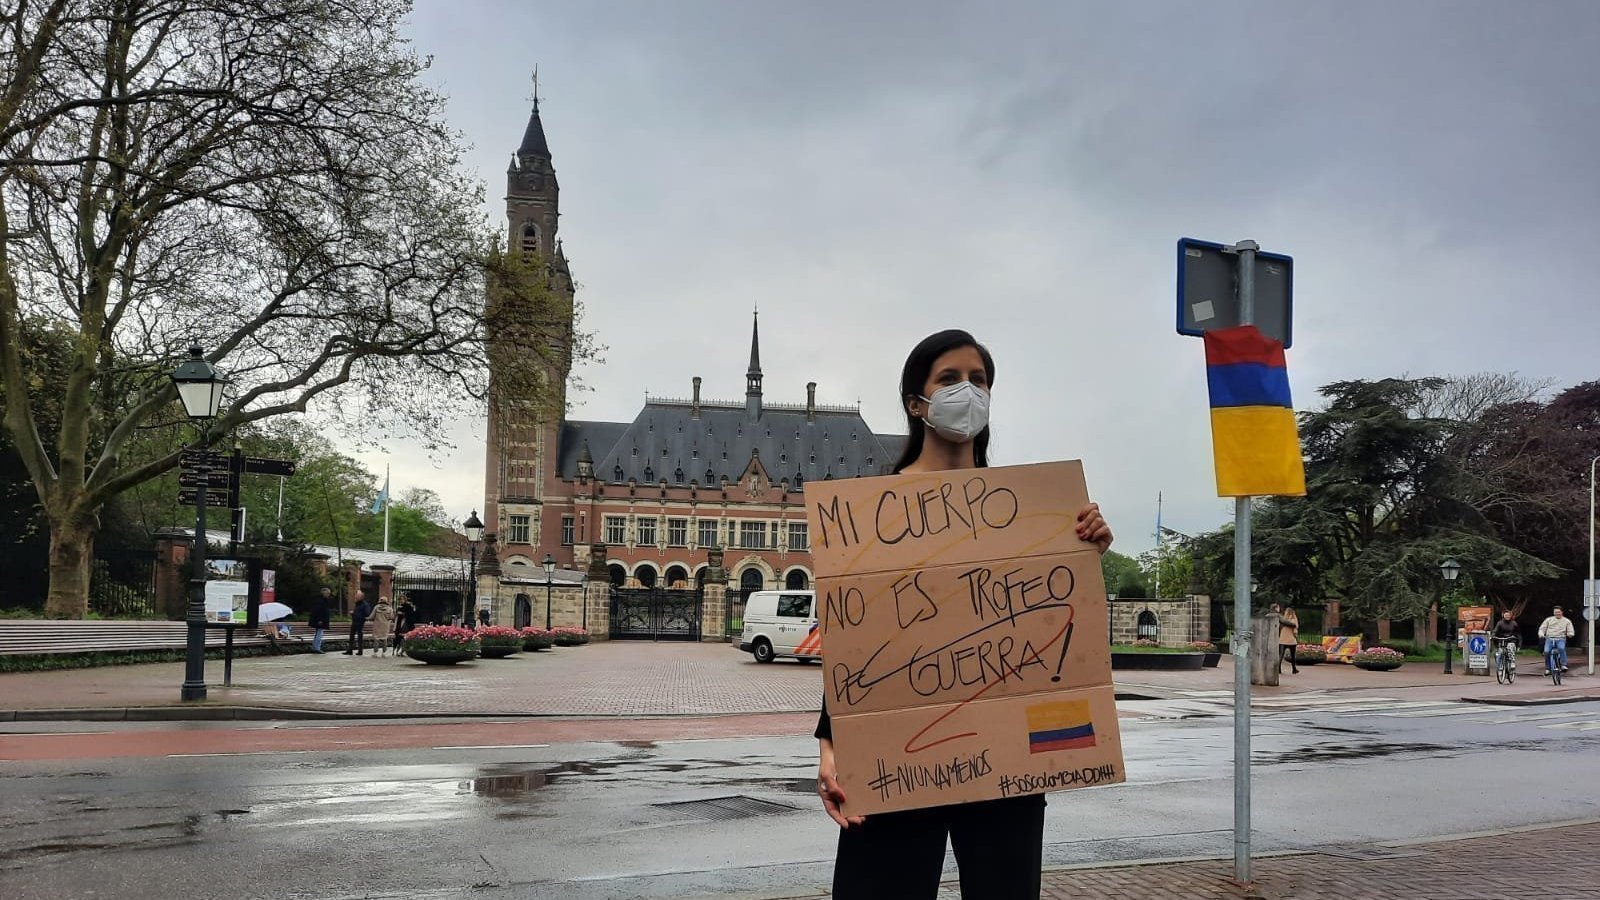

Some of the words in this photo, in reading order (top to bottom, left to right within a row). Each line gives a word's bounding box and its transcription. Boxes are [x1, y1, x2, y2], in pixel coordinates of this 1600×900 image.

[817, 495, 859, 549] MI
[876, 477, 1018, 544] CUERPO
[824, 586, 865, 634] NO
[891, 571, 938, 629] ES
[958, 565, 1075, 627] TROFEO
[908, 622, 1074, 697] GUERRA!
[867, 749, 993, 802] #NIUNAMENOS
